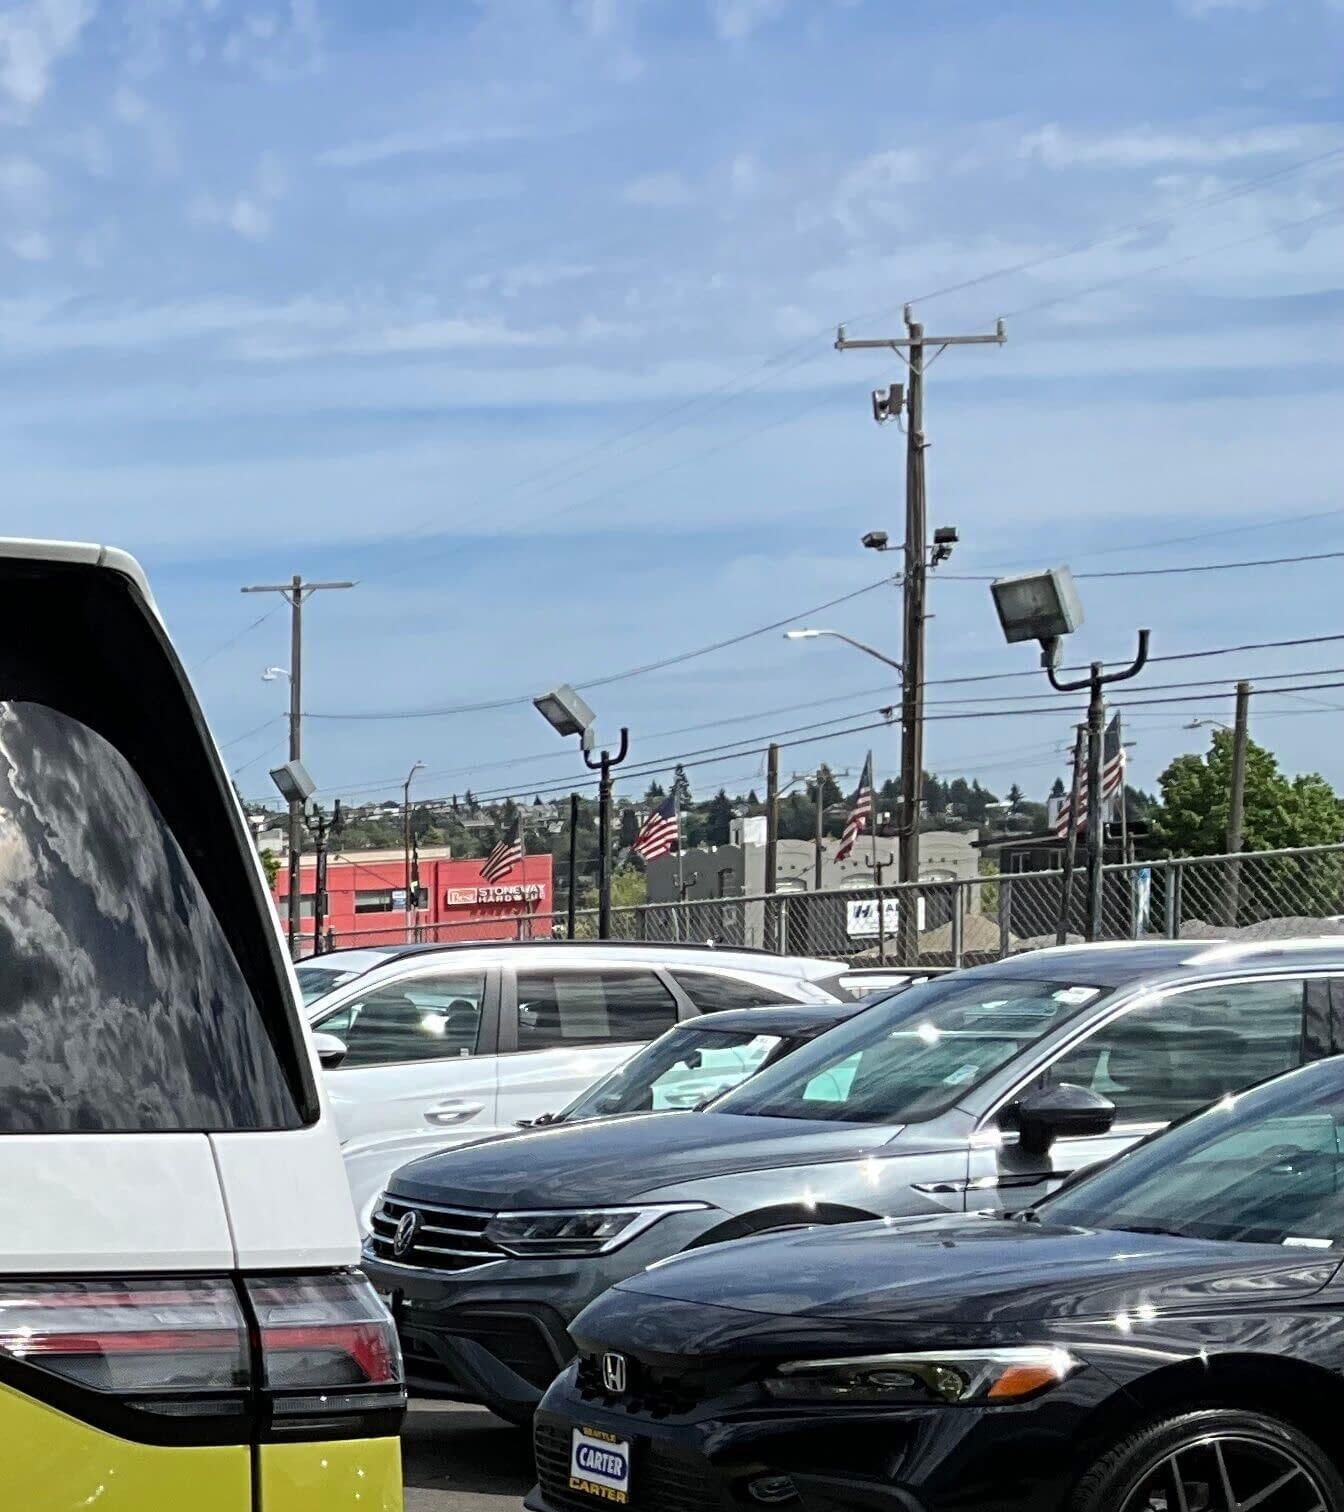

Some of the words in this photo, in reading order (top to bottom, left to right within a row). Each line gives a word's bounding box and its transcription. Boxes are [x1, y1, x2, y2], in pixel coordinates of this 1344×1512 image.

[582, 1426, 617, 1443] SEATTLE
[579, 1447, 623, 1476] CARTER
[569, 1477, 626, 1504] CARTER
